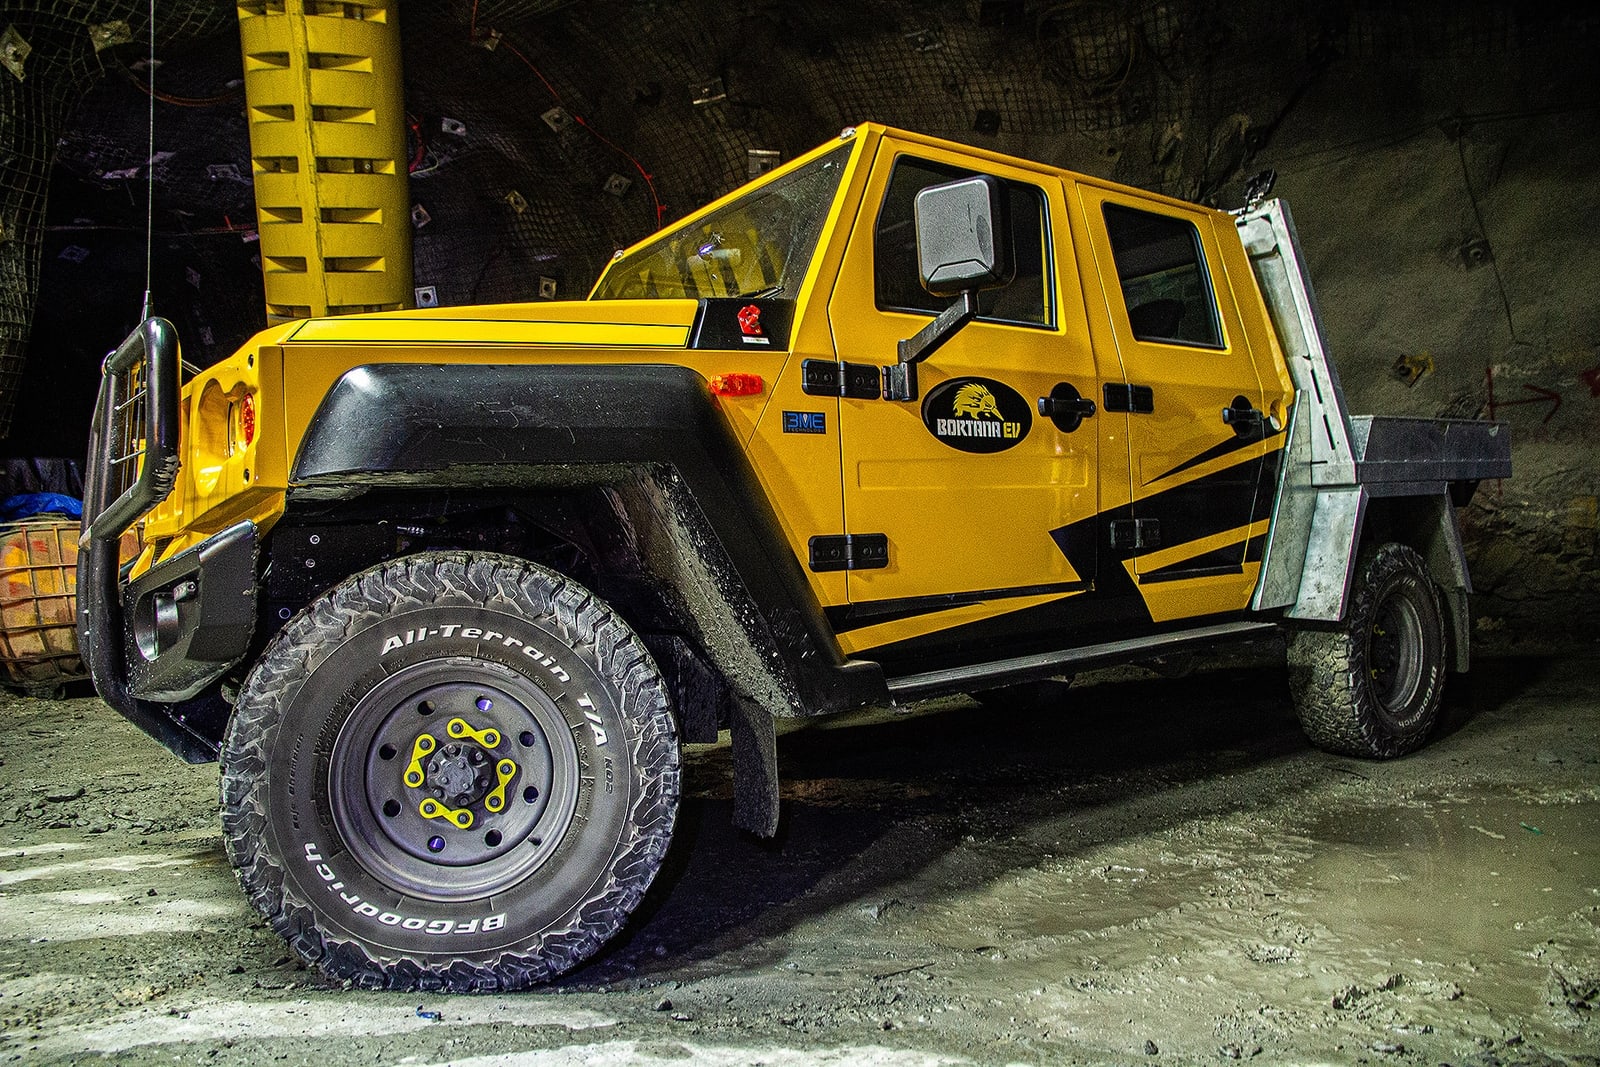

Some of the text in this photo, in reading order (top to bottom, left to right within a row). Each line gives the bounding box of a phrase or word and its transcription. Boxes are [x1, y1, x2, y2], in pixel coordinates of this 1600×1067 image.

[936, 418, 1021, 438] BORTANA EV
[380, 623, 572, 684] All-Terrain
[577, 692, 608, 746] T/A
[303, 842, 507, 935] BFGoodrich
